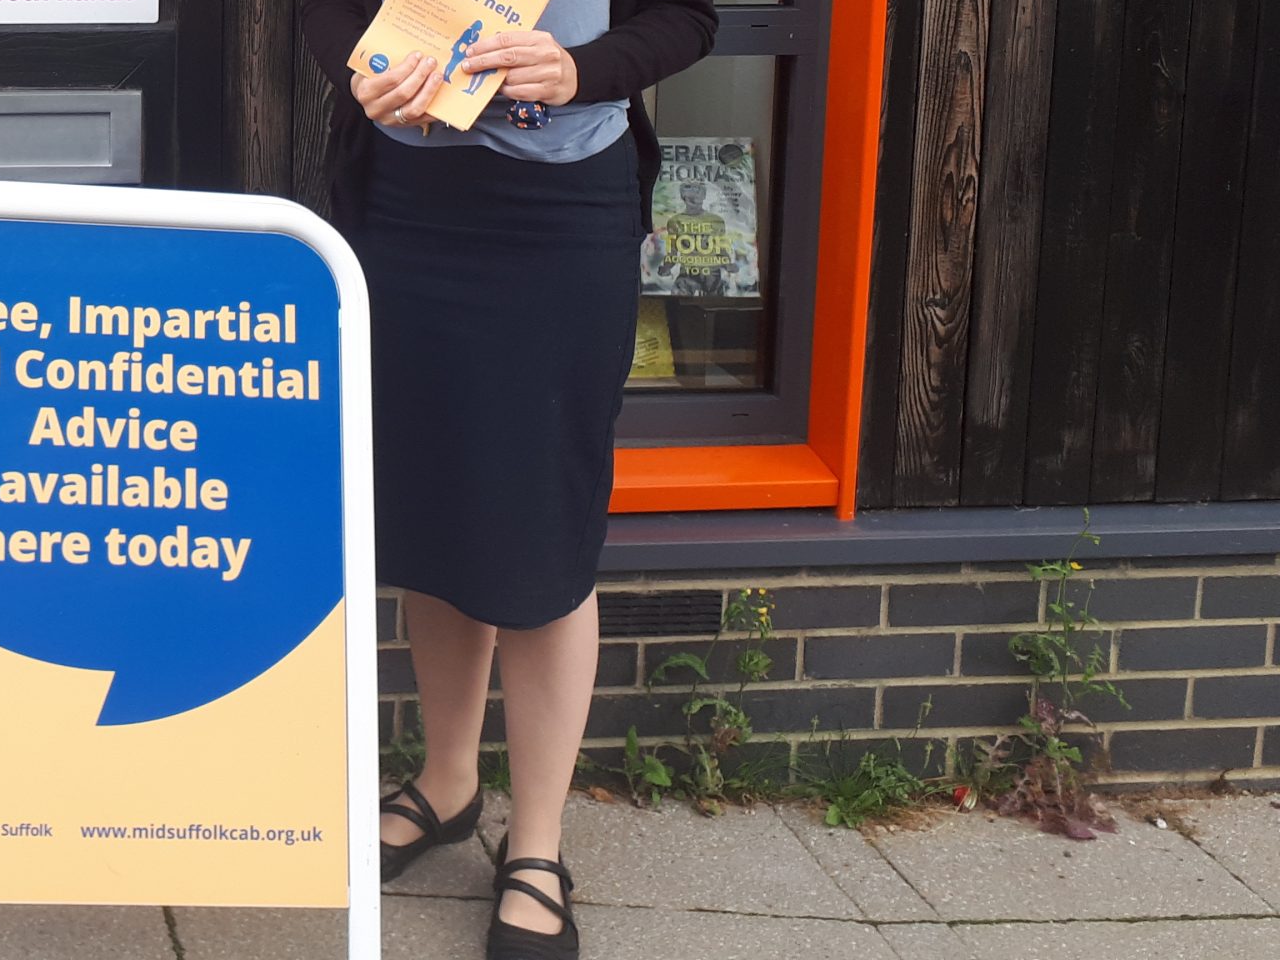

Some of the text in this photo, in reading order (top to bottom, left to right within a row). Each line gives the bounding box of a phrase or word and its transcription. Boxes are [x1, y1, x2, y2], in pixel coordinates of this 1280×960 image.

[660, 145, 720, 162] ERAI
[658, 164, 744, 182] HOMAS
[682, 223, 713, 233] THE
[665, 235, 733, 256] TOUR
[664, 255, 730, 265] ACCORDING
[685, 267, 700, 276] TO
[68, 296, 297, 348] Impartial
[14, 349, 320, 401] Confidential
[28, 406, 198, 452] Advice
[105, 525, 252, 581] today
[1, 822, 53, 838] Suffolk
[80, 823, 323, 846] www.midsuffolkcab.org.uk
